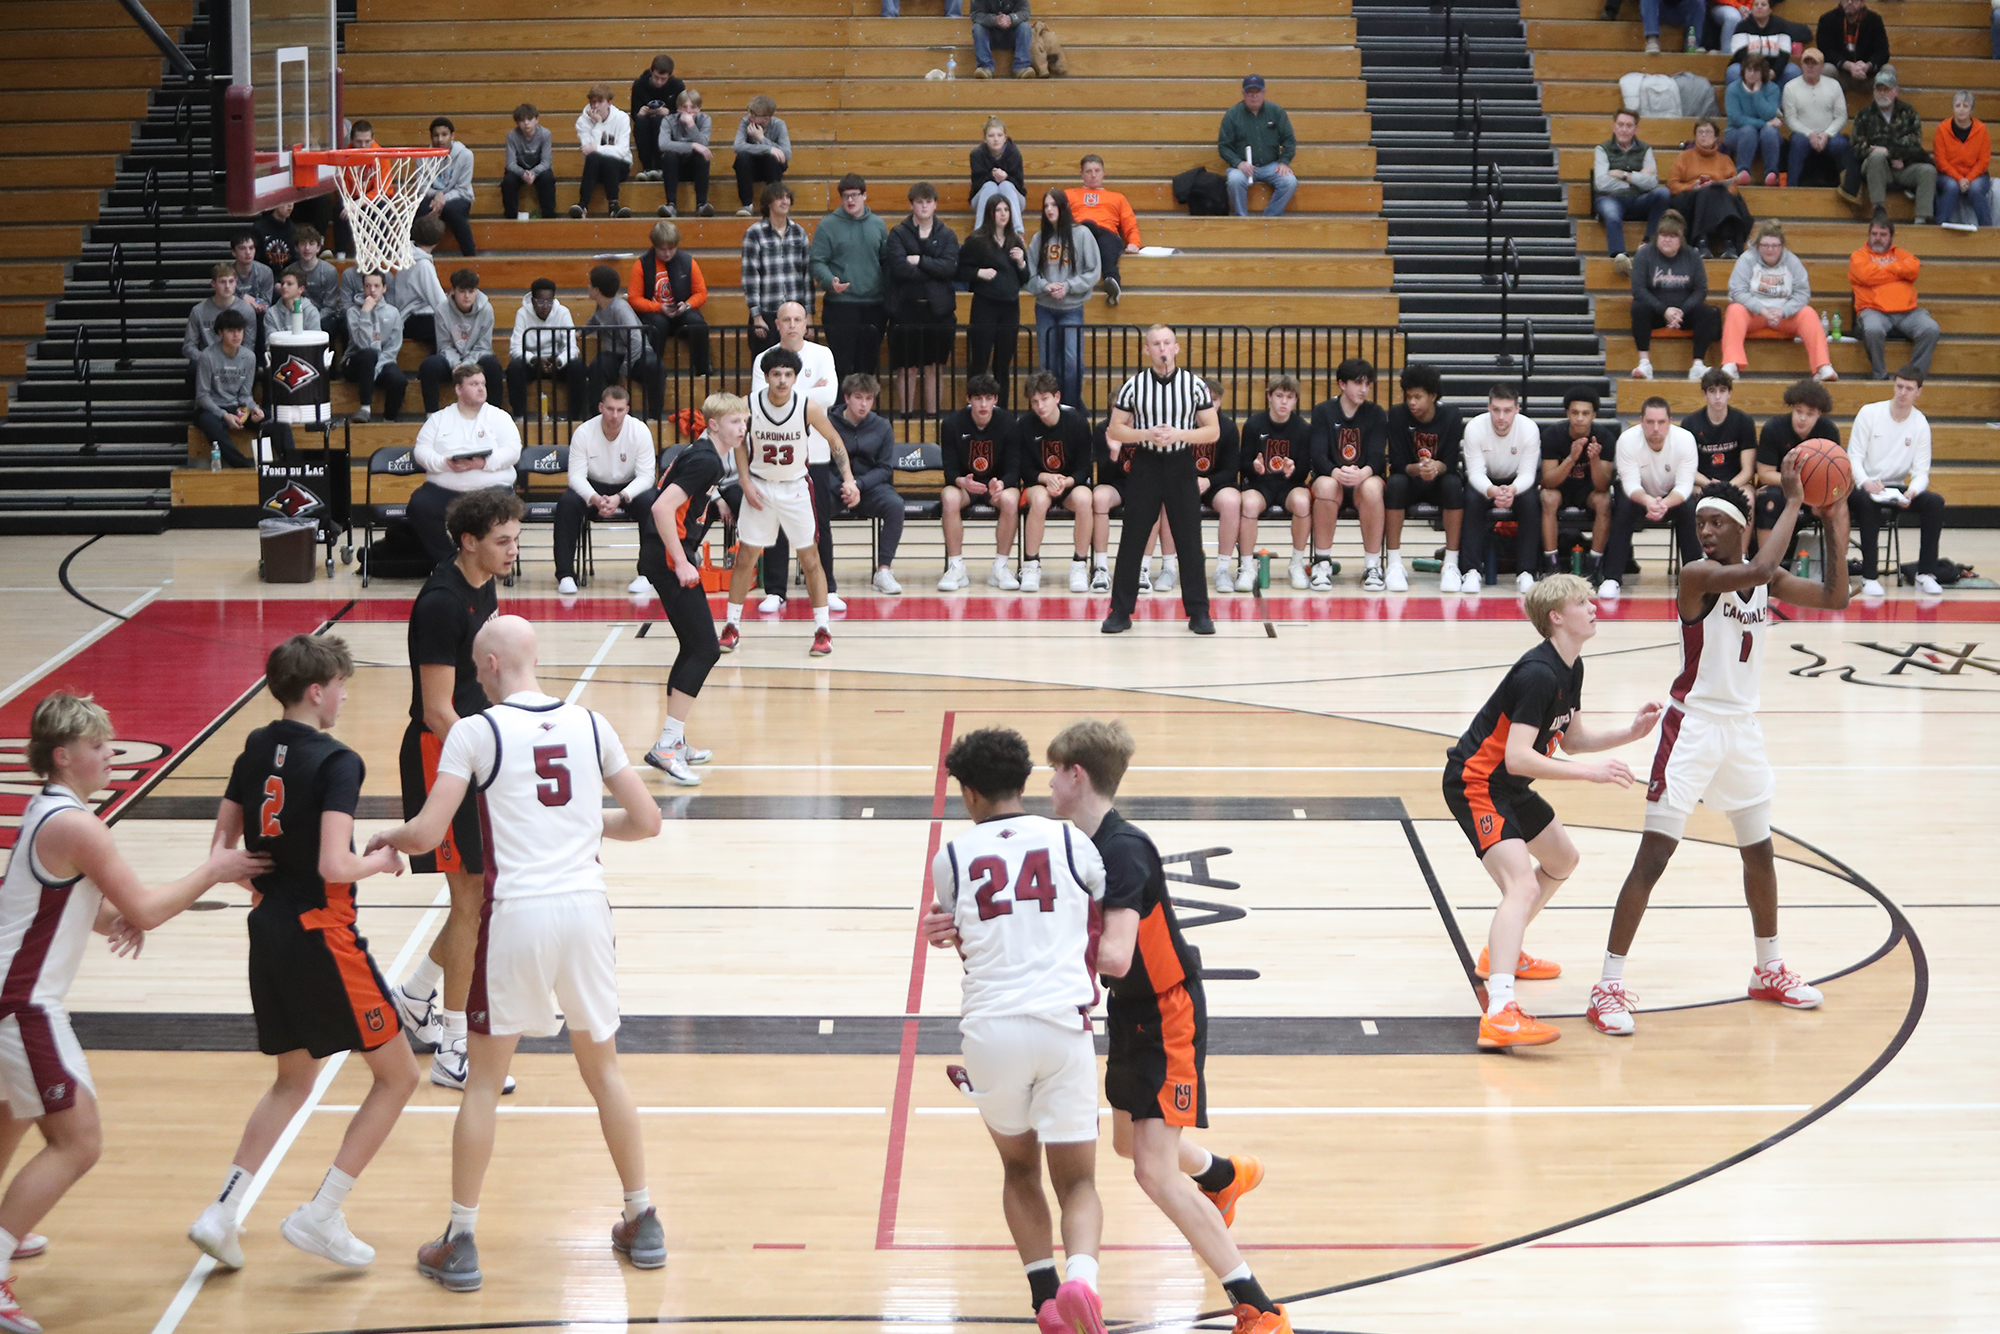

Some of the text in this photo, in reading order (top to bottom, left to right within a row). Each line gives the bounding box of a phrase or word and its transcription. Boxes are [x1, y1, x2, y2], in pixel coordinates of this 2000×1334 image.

[755, 430, 801, 441] CARDINALS
[761, 444, 795, 466] 23
[898, 457, 926, 467] EXCEL
[262, 464, 325, 476] FOND DU LAC
[388, 460, 414, 471] EXCEL
[534, 459, 561, 470] EXCEL
[1739, 630, 1753, 662] 1
[532, 743, 573, 808] 5
[259, 774, 285, 838] 2
[968, 847, 1058, 922] 24
